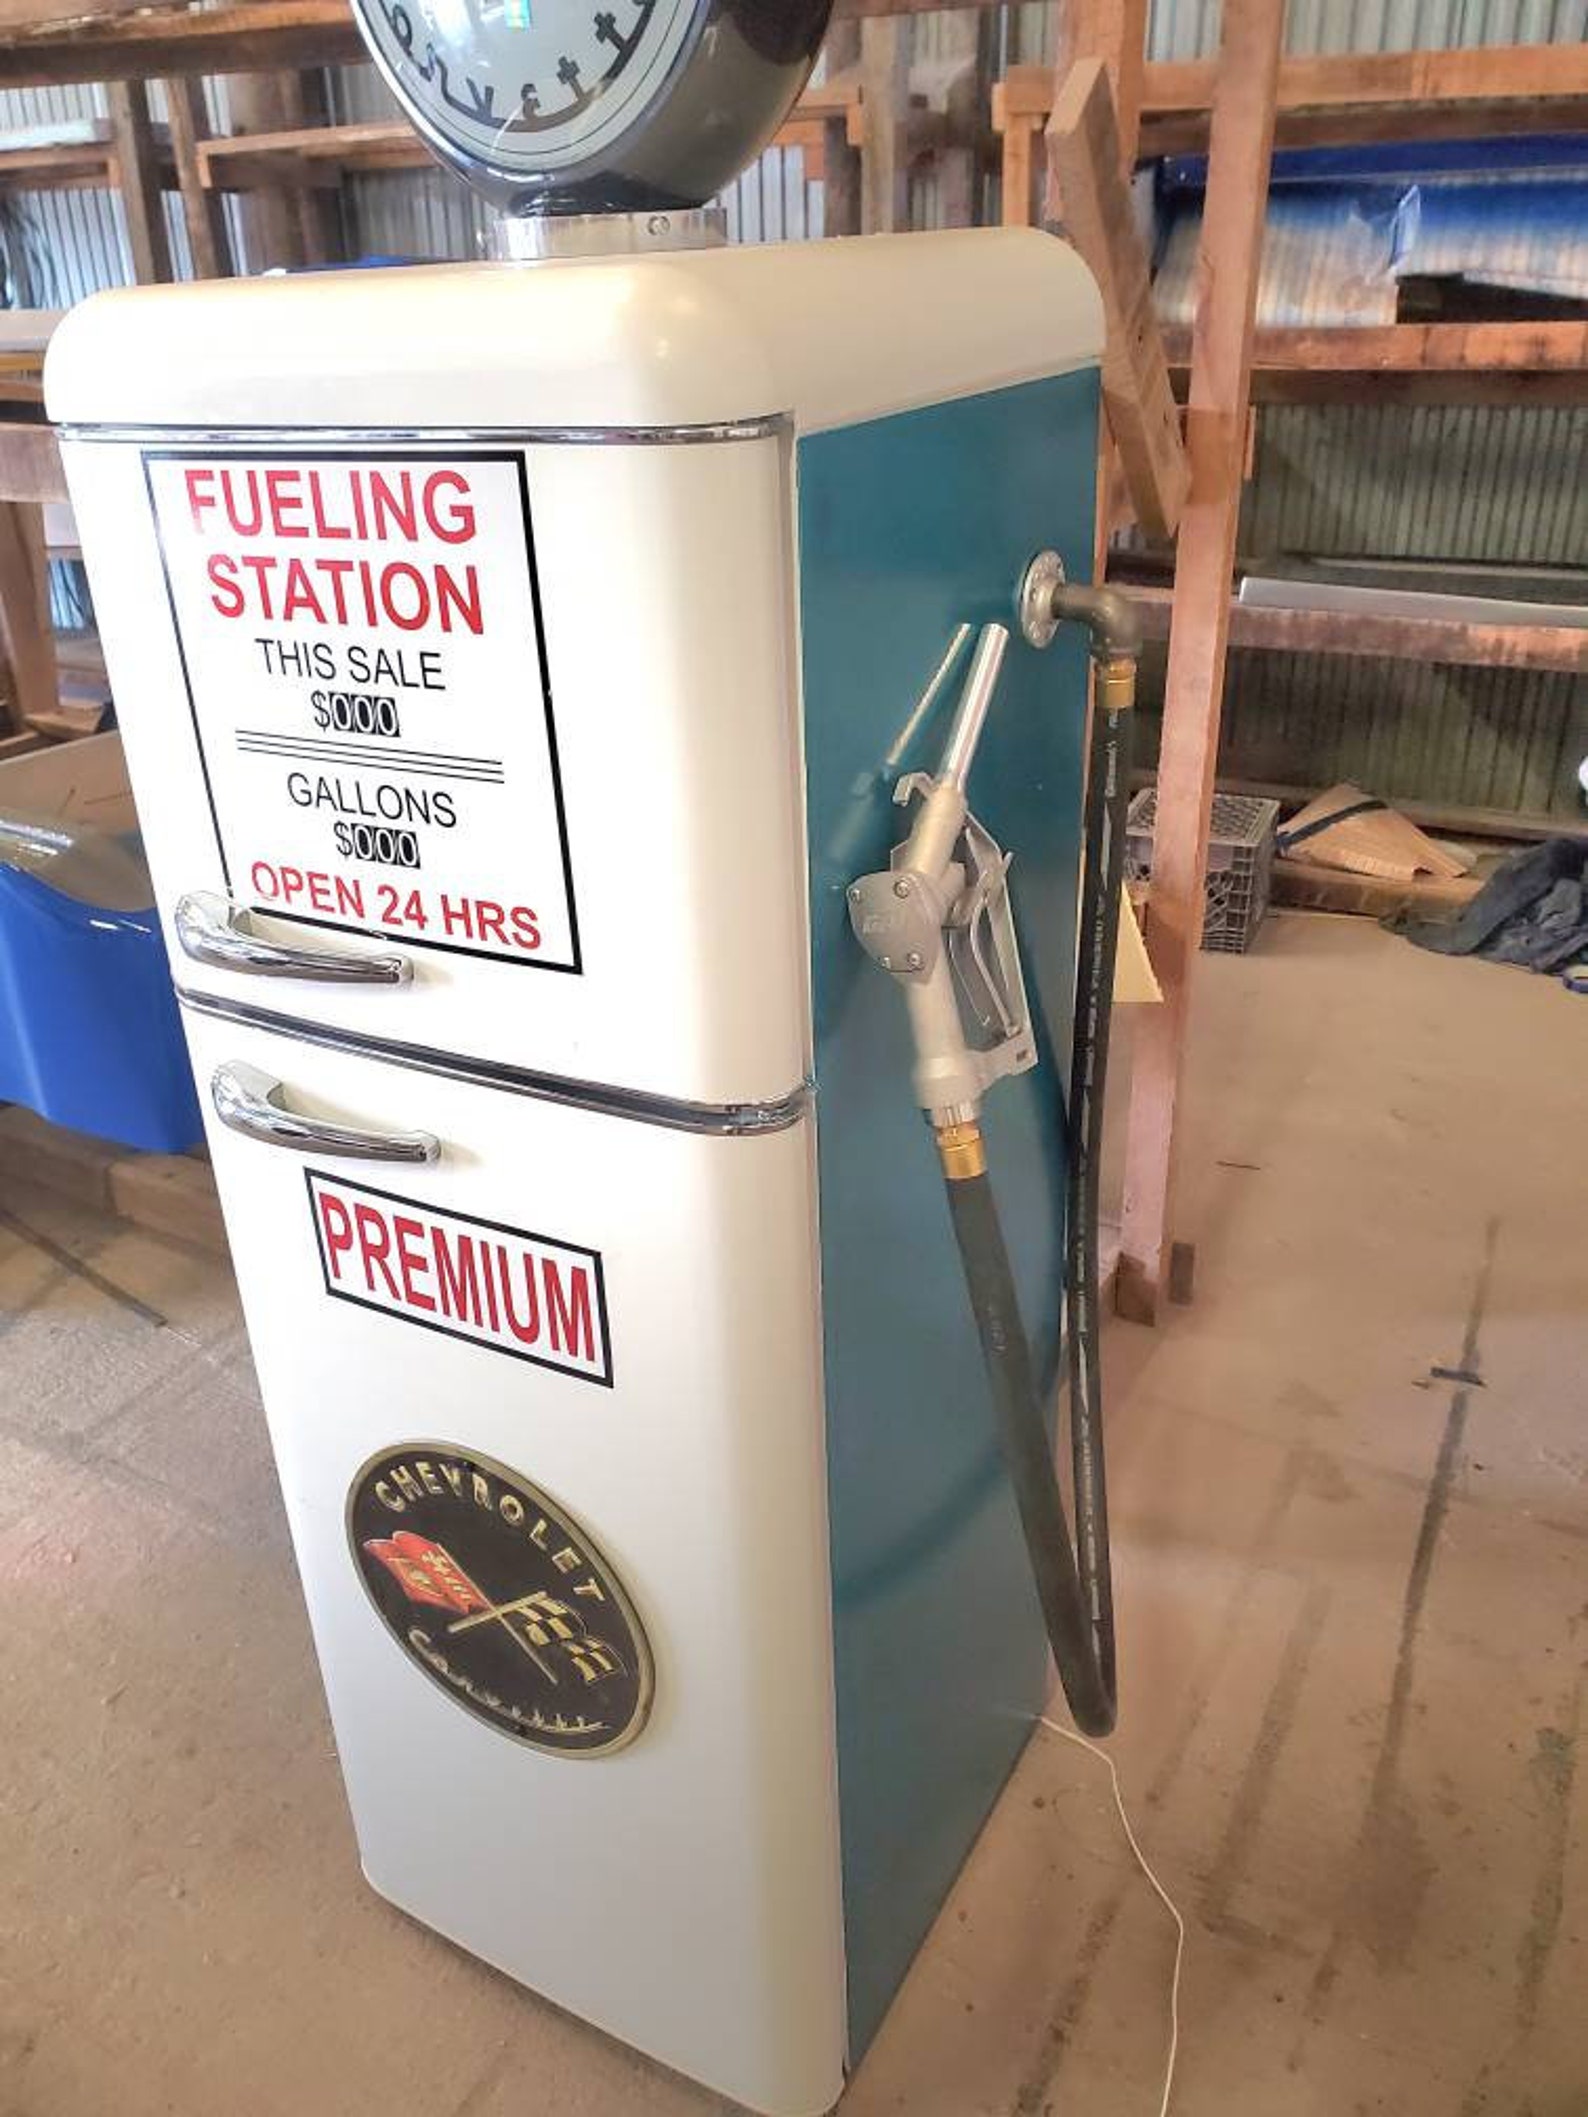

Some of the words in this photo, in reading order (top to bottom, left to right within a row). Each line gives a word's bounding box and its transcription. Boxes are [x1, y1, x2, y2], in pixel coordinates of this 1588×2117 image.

[184, 469, 477, 545] FUELING
[206, 553, 484, 635] STATION
[255, 638, 337, 680] THIS
[347, 645, 447, 691] SALE
[287, 772, 457, 829] GALLONS
[251, 861, 365, 920] OPEN
[376, 884, 428, 931] 24
[440, 893, 542, 950] HRS
[318, 1191, 596, 1362] PREMIUM
[374, 1460, 606, 1602] CHEVROLET
